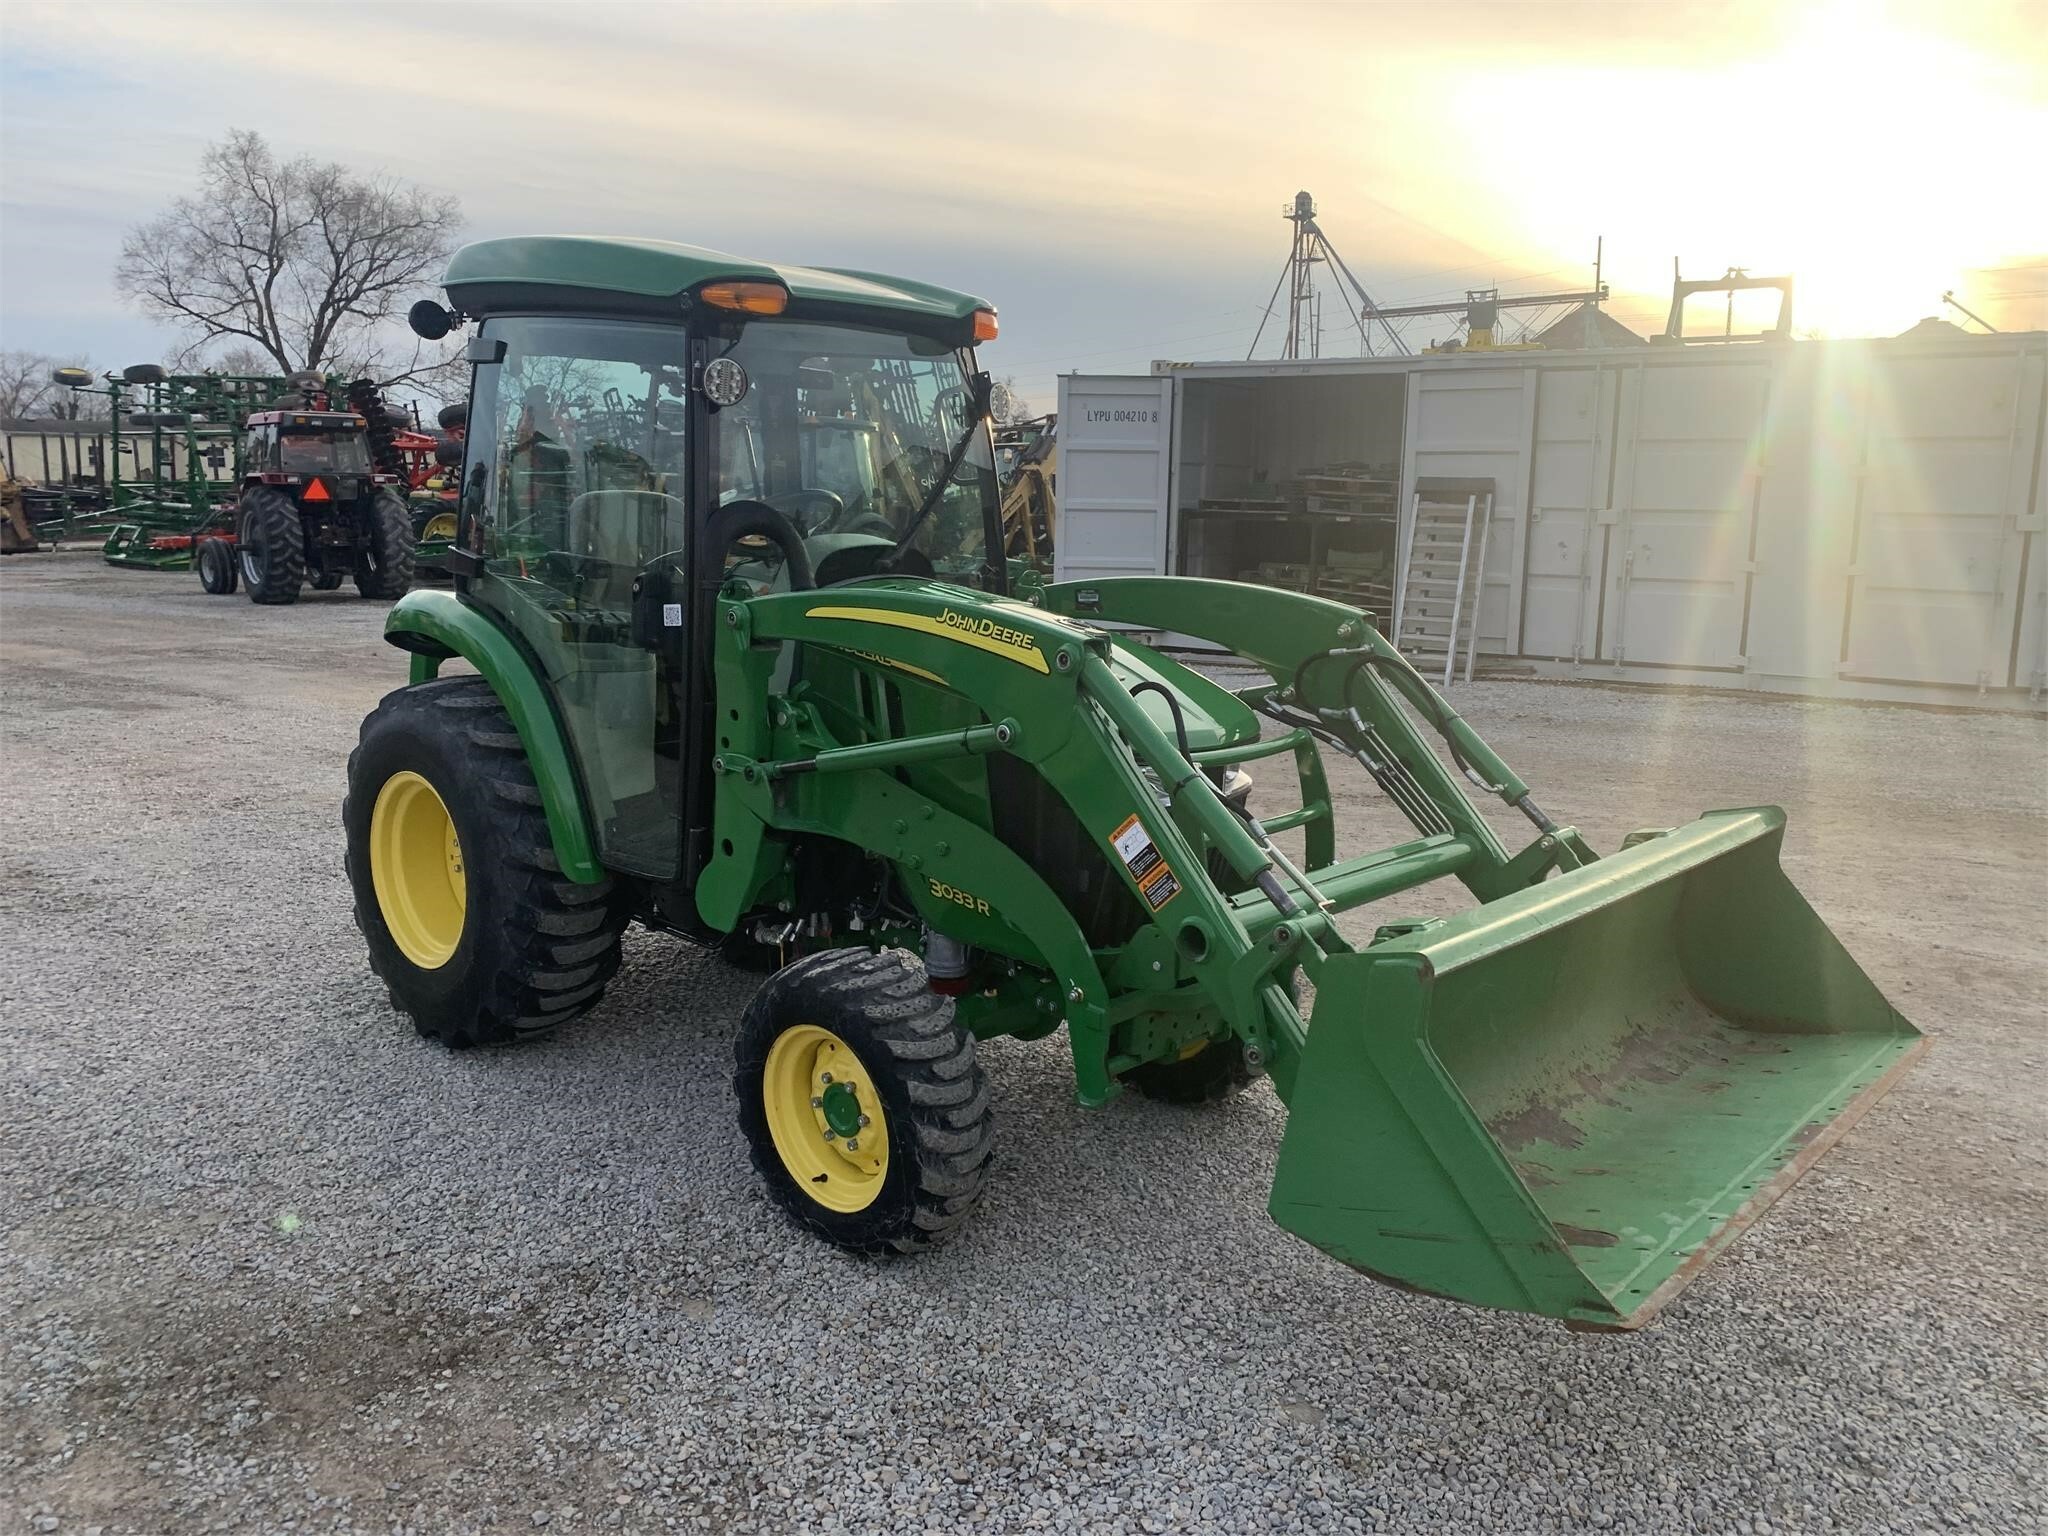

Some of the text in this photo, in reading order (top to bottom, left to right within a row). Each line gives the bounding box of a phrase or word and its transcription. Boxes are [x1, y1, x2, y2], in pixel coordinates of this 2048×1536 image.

[1087, 410, 1158, 423] LYPU 004210 8
[936, 608, 1034, 649] JOHN DEERE
[929, 878, 990, 917] 3033 R
